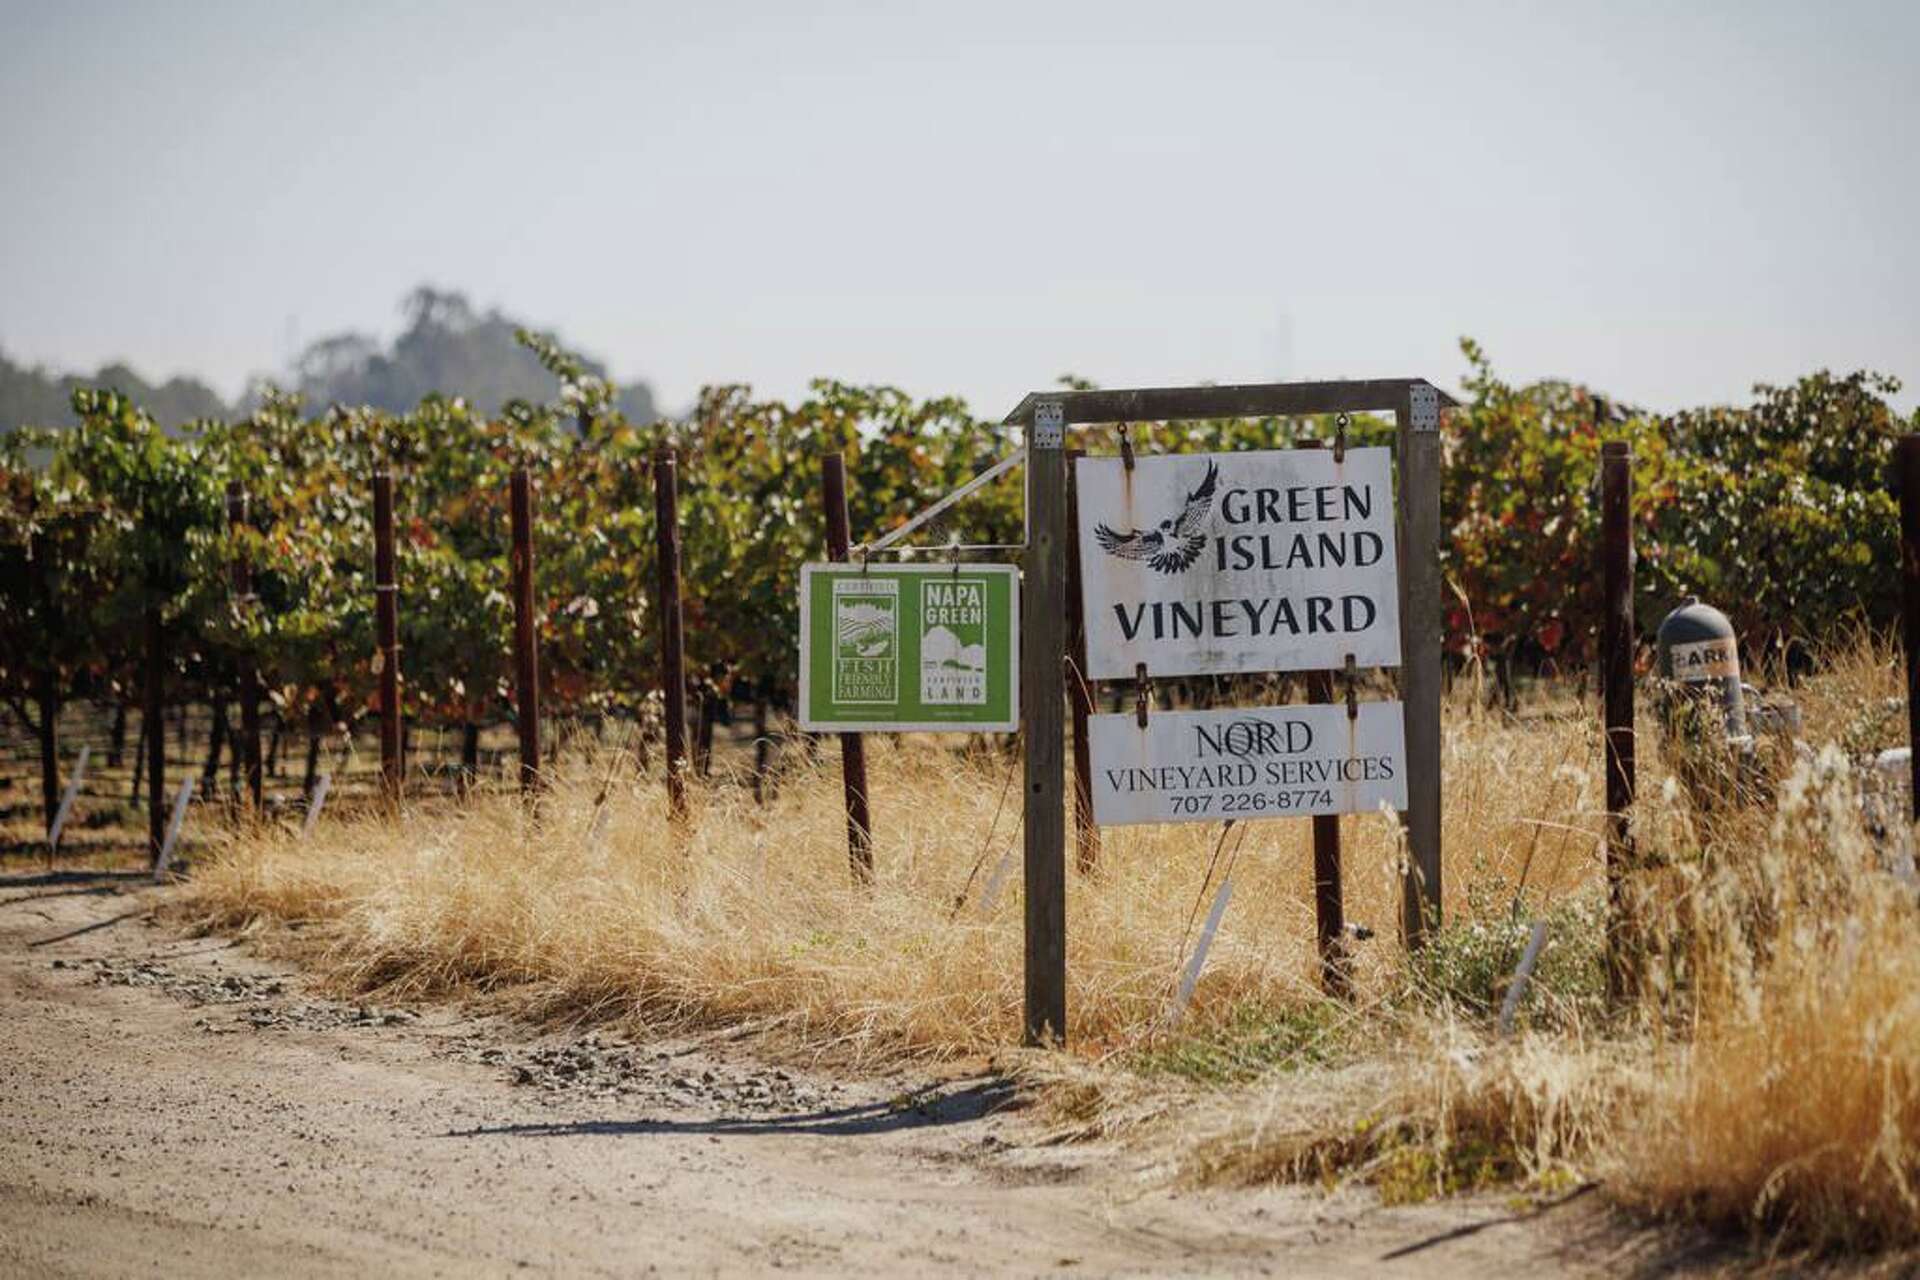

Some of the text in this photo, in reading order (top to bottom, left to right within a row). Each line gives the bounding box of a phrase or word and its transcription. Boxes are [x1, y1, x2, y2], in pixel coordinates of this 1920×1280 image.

[1221, 484, 1371, 525] GREEN
[1215, 531, 1383, 572] ISLAND
[926, 584, 981, 607] NAPA
[926, 607, 982, 625] GREEN
[1113, 595, 1377, 641] VINEYARD
[927, 686, 981, 699] LAND
[1195, 720, 1313, 758] NORD
[1106, 756, 1394, 792] VINEYARD SERVICES
[1170, 789, 1333, 815] 707 226-8774
